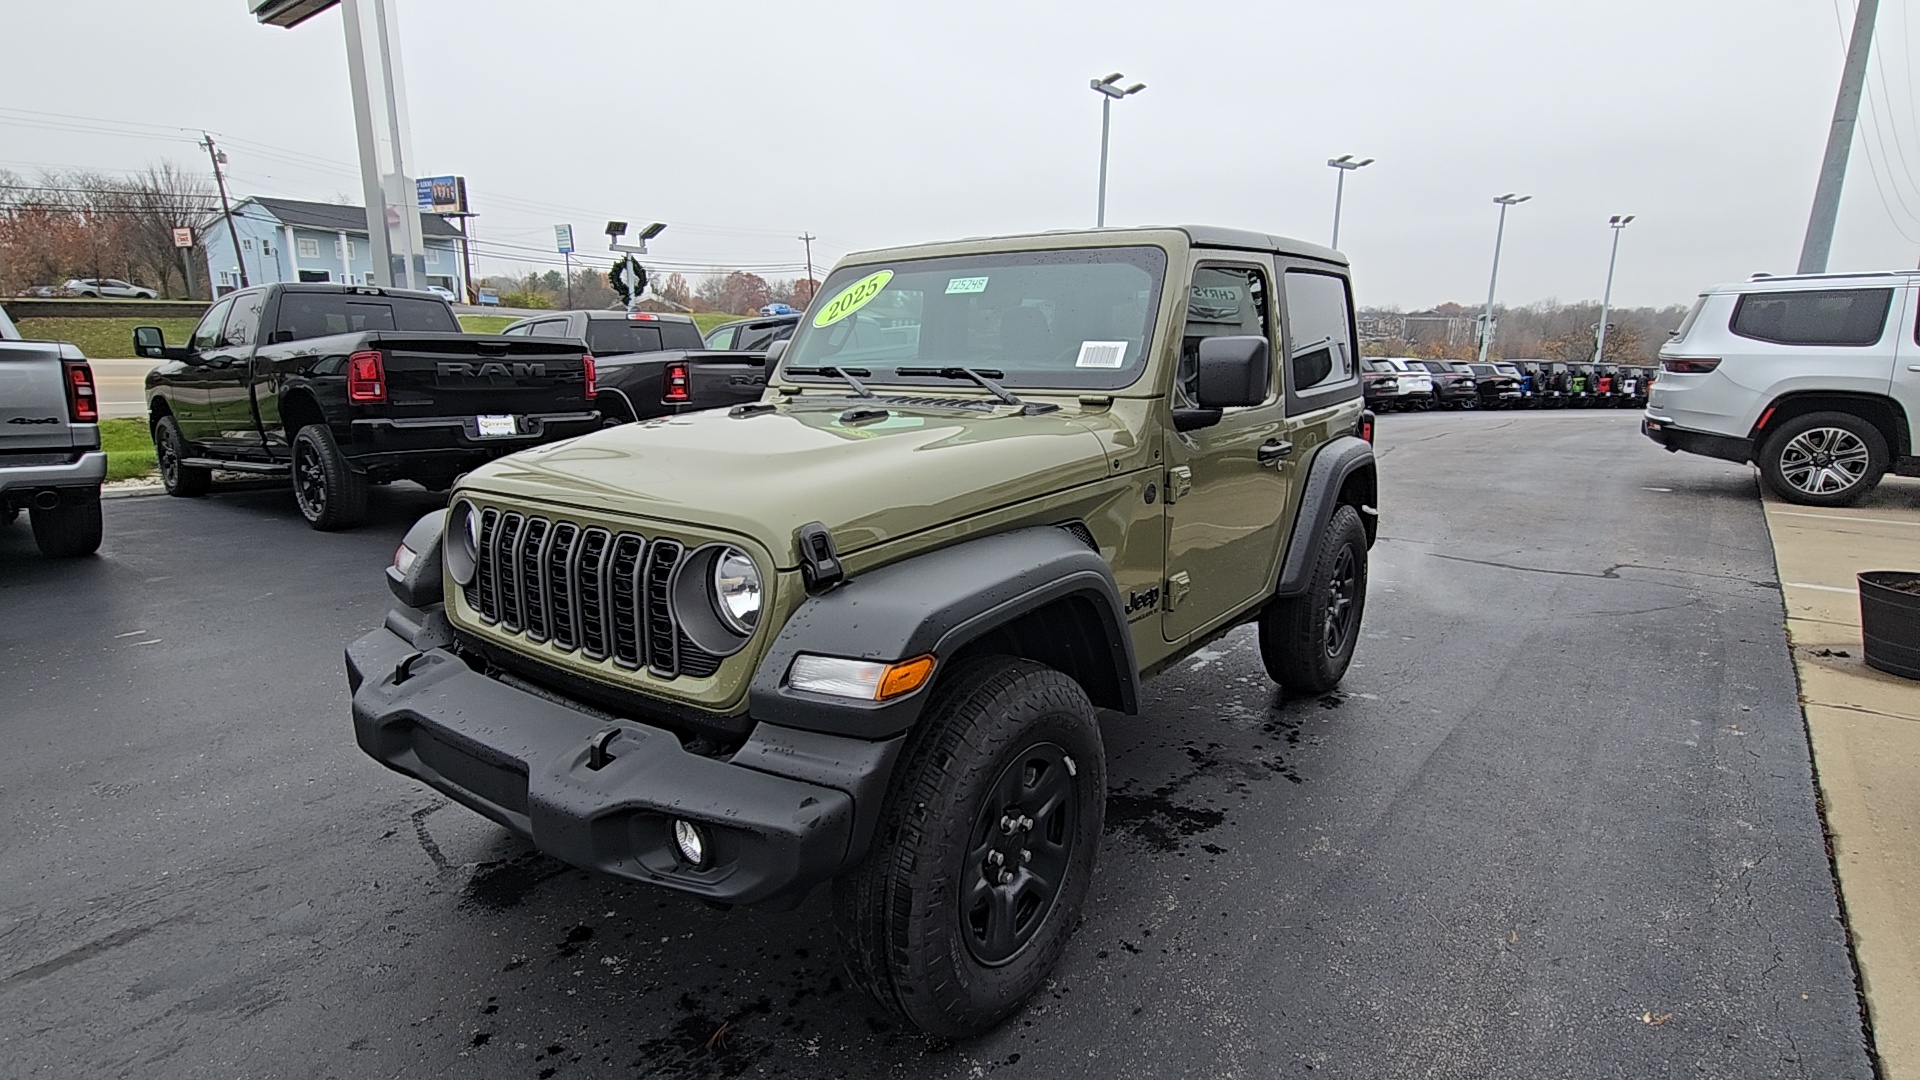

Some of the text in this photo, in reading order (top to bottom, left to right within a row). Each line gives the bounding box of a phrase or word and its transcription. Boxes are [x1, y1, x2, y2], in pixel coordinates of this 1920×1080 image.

[827, 276, 879, 322] 2025
[437, 362, 546, 377] RAM
[1125, 586, 1159, 615] Jeep
